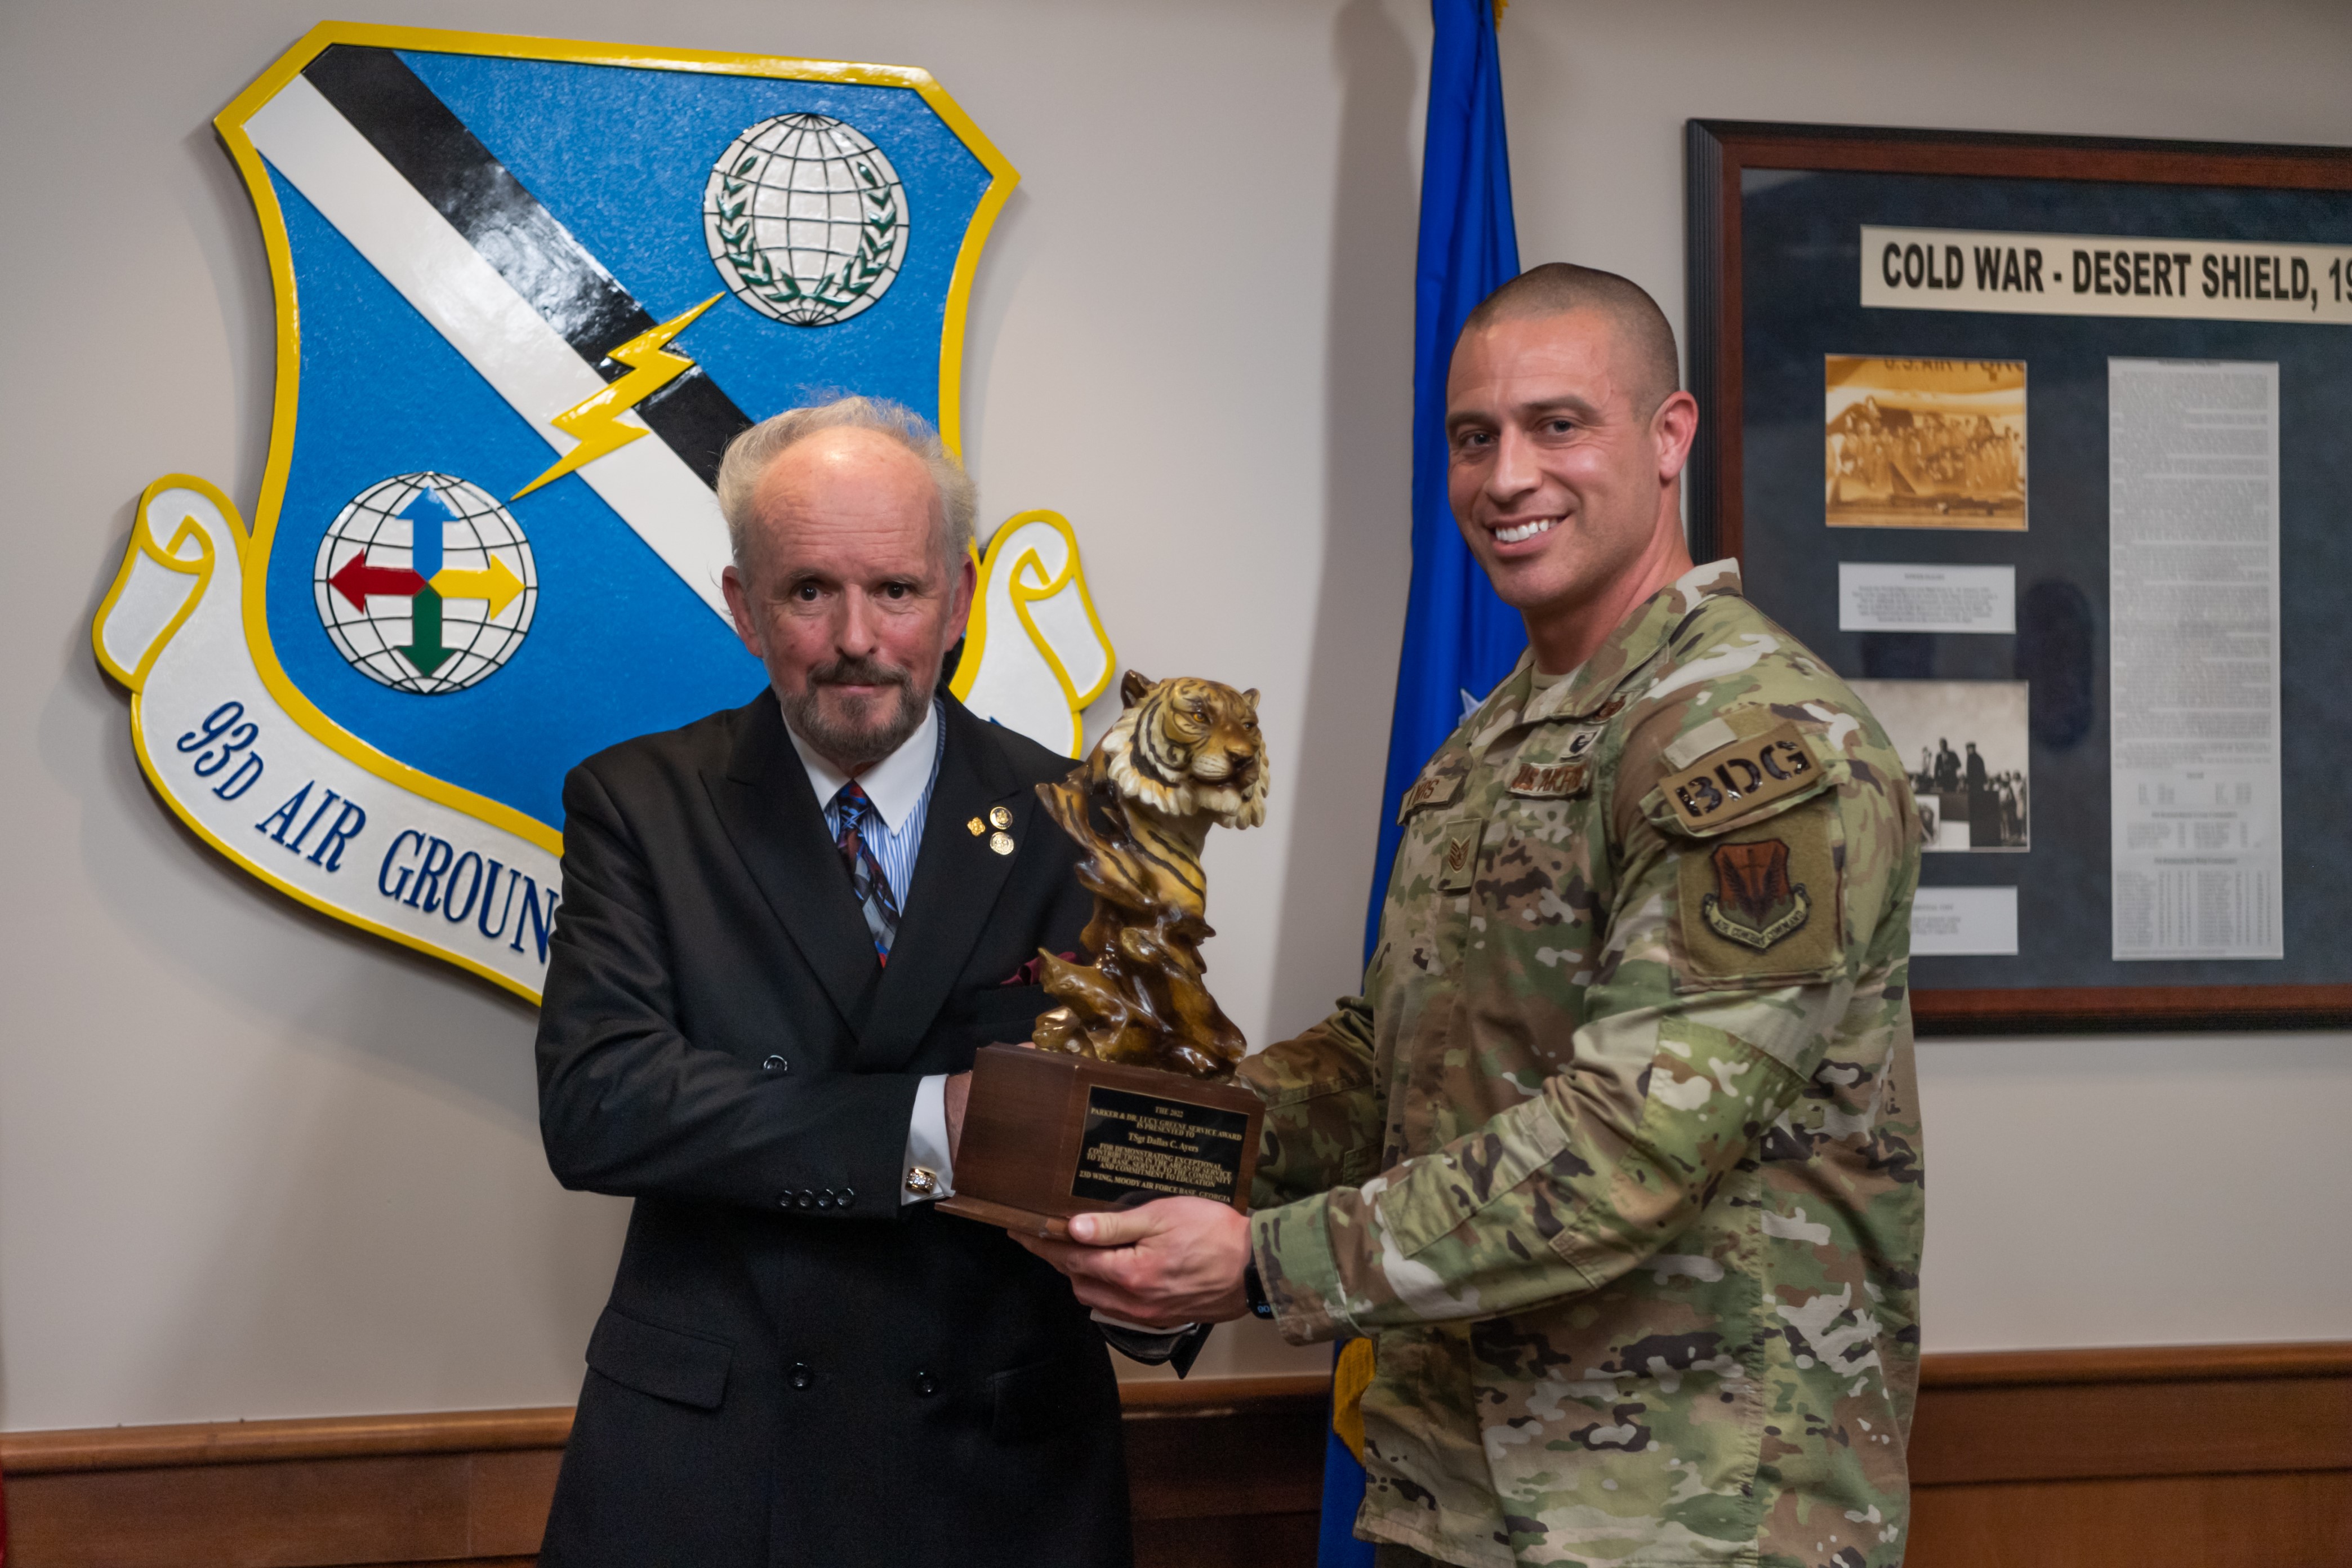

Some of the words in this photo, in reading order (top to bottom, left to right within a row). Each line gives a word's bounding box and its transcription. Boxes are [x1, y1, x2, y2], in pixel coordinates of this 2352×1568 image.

[1882, 242, 1965, 289] COLD
[1974, 246, 2044, 293] WAR
[2053, 271, 2063, 282] -
[2073, 249, 2192, 299] DESERT
[2201, 252, 2318, 313] SHIELD,
[1676, 740, 1812, 818] BDG
[176, 700, 264, 801] 93D
[255, 779, 367, 873] AIR
[377, 828, 560, 965] GROUN
[1155, 1106, 1169, 1115] THE
[1090, 1107, 1119, 1118] PARKER
[1188, 1125, 1217, 1136] SERVICE
[1218, 1130, 1242, 1141] AWARD
[1088, 1147, 1144, 1160] CONTRIBUTIONS
[1128, 1132, 1145, 1144] TSgt
[1147, 1135, 1168, 1147] Dallas
[1179, 1142, 1199, 1152] Ayers
[1115, 1146, 1174, 1160] DEMONSTRATING
[1175, 1156, 1222, 1169] EXCEPTIONAL
[1093, 1173, 1113, 1182] WING,
[1114, 1176, 1141, 1187] MOODY
[1141, 1181, 1154, 1190] AIR
[1155, 1183, 1178, 1193] FORCE
[1199, 1191, 1231, 1202] GEORGIA
[1099, 1162, 1115, 1170] AND
[1176, 1175, 1216, 1188] EDUCATION
[1188, 1171, 1232, 1184] COMMUNITY
